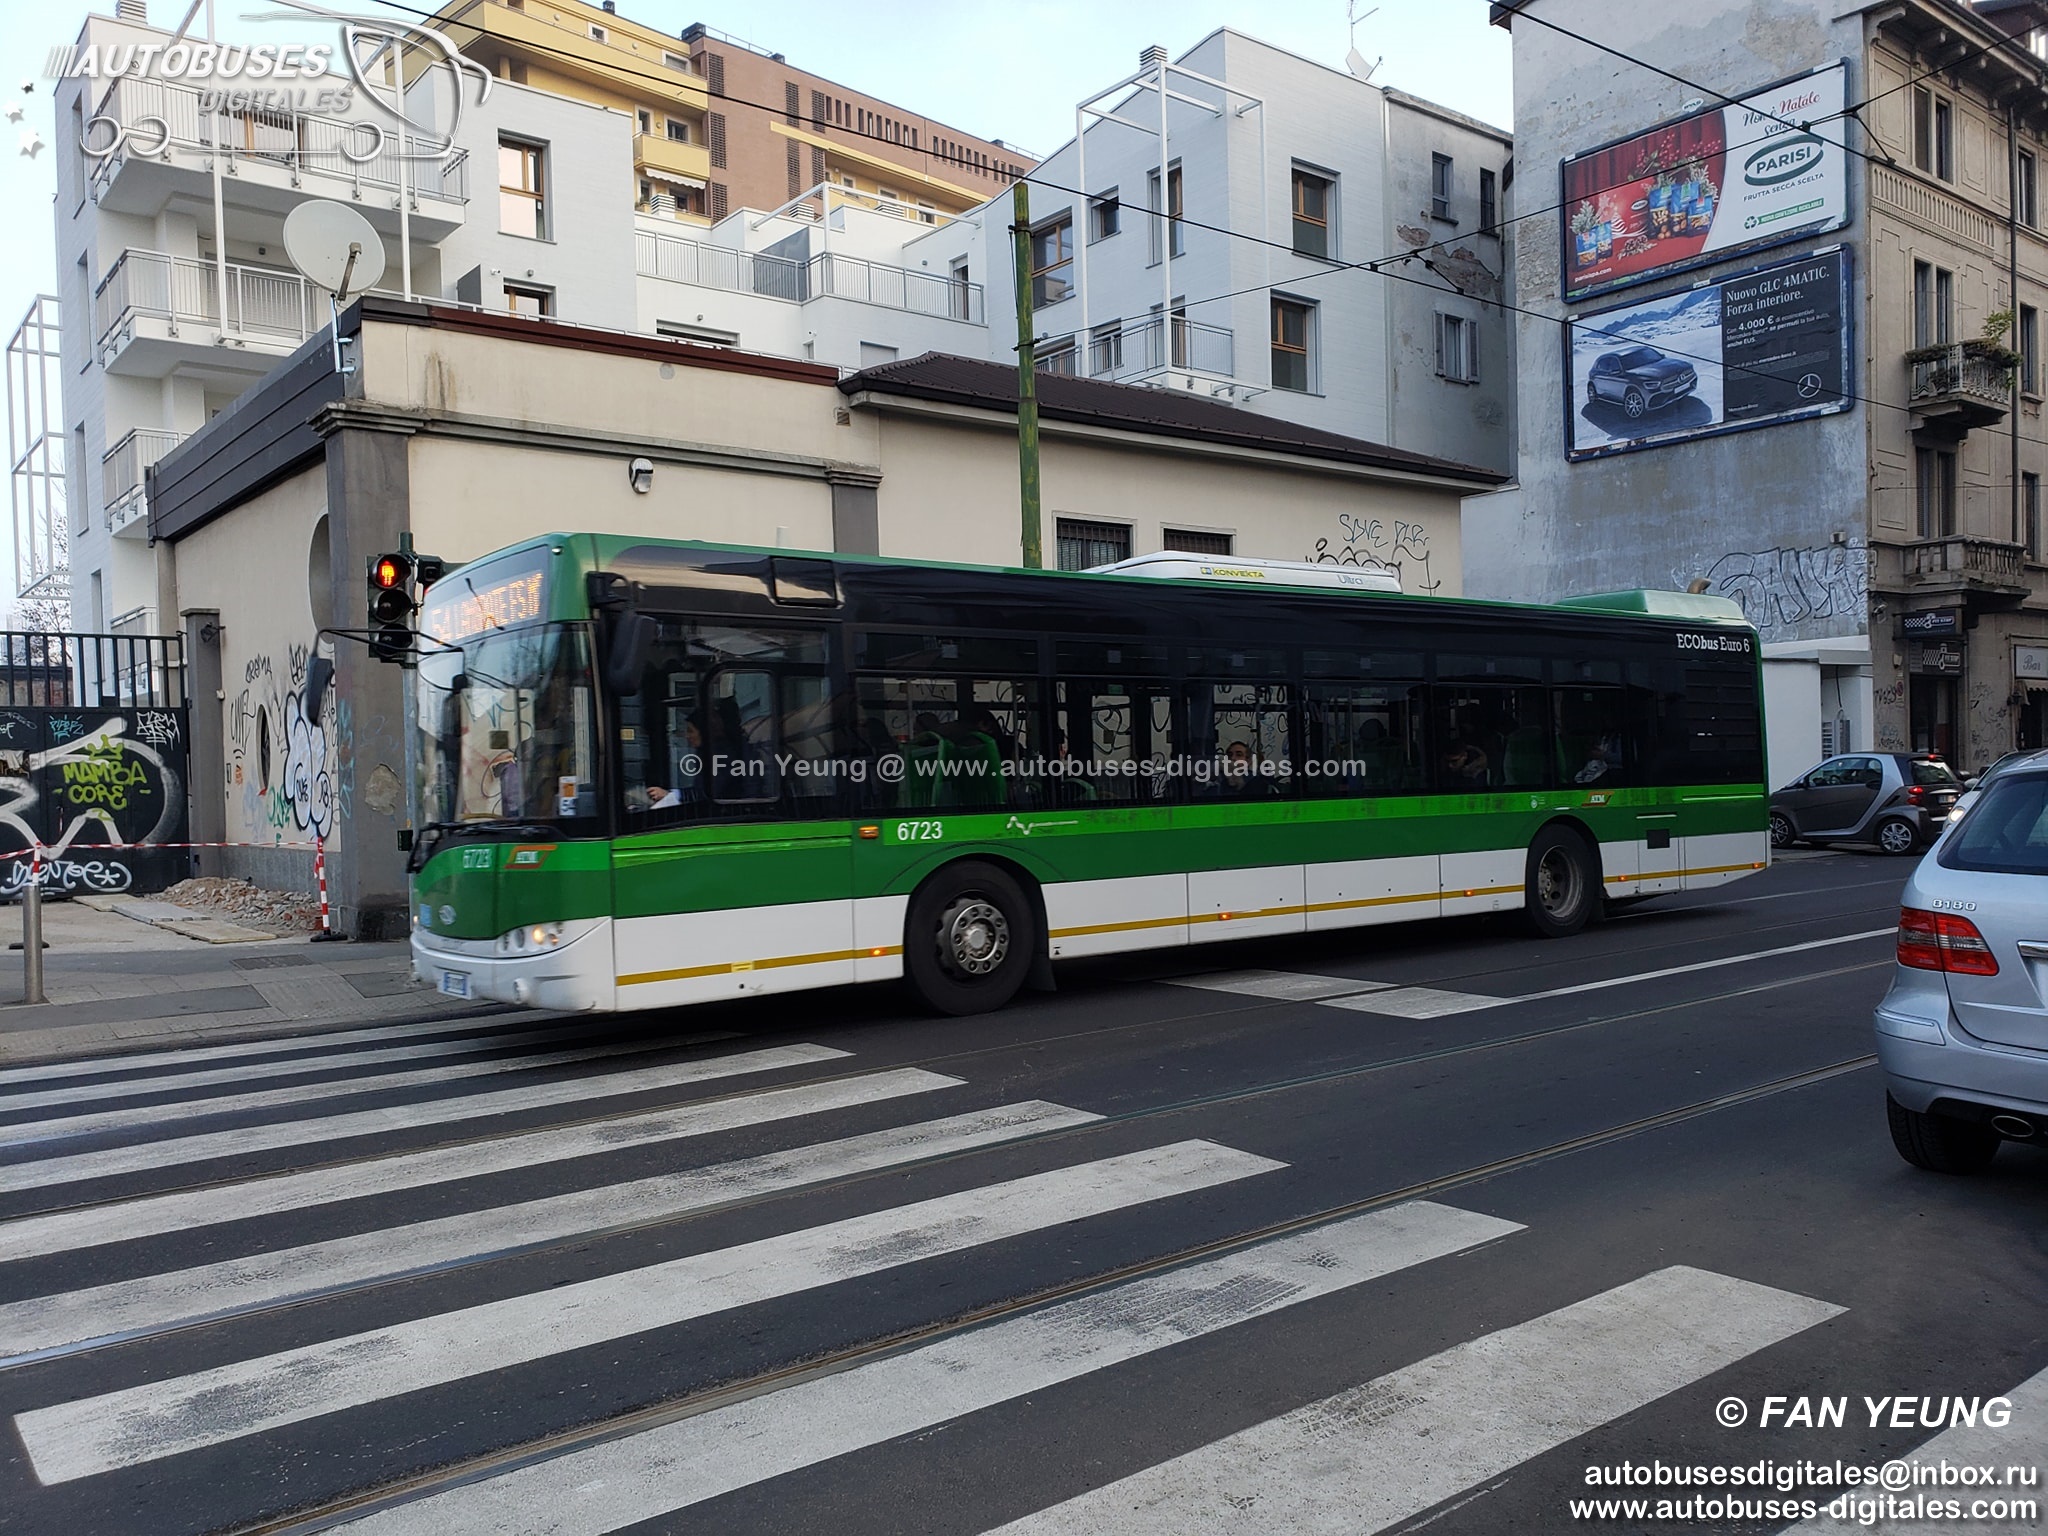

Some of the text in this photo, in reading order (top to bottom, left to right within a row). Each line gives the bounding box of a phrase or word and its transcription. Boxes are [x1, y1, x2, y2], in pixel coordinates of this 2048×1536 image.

[1780, 91, 1821, 114] Natale
[1756, 146, 1811, 174] PARISI
[1744, 173, 1824, 202] FRUTTA SECCA SCELTA
[1726, 266, 1830, 303] Nuovo GLC 4MATIC.
[1726, 290, 1804, 317] Forza interiore.
[1738, 318, 1765, 331] 4.000
[1767, 315, 1774, 324] €
[1213, 567, 1265, 579] KONVEKTA
[1337, 574, 1363, 586] Ultra
[1676, 633, 1751, 653] ECObus Euro 6
[2022, 654, 2041, 671] Bar
[63, 761, 147, 786] MAMBA
[897, 821, 943, 841] 6723
